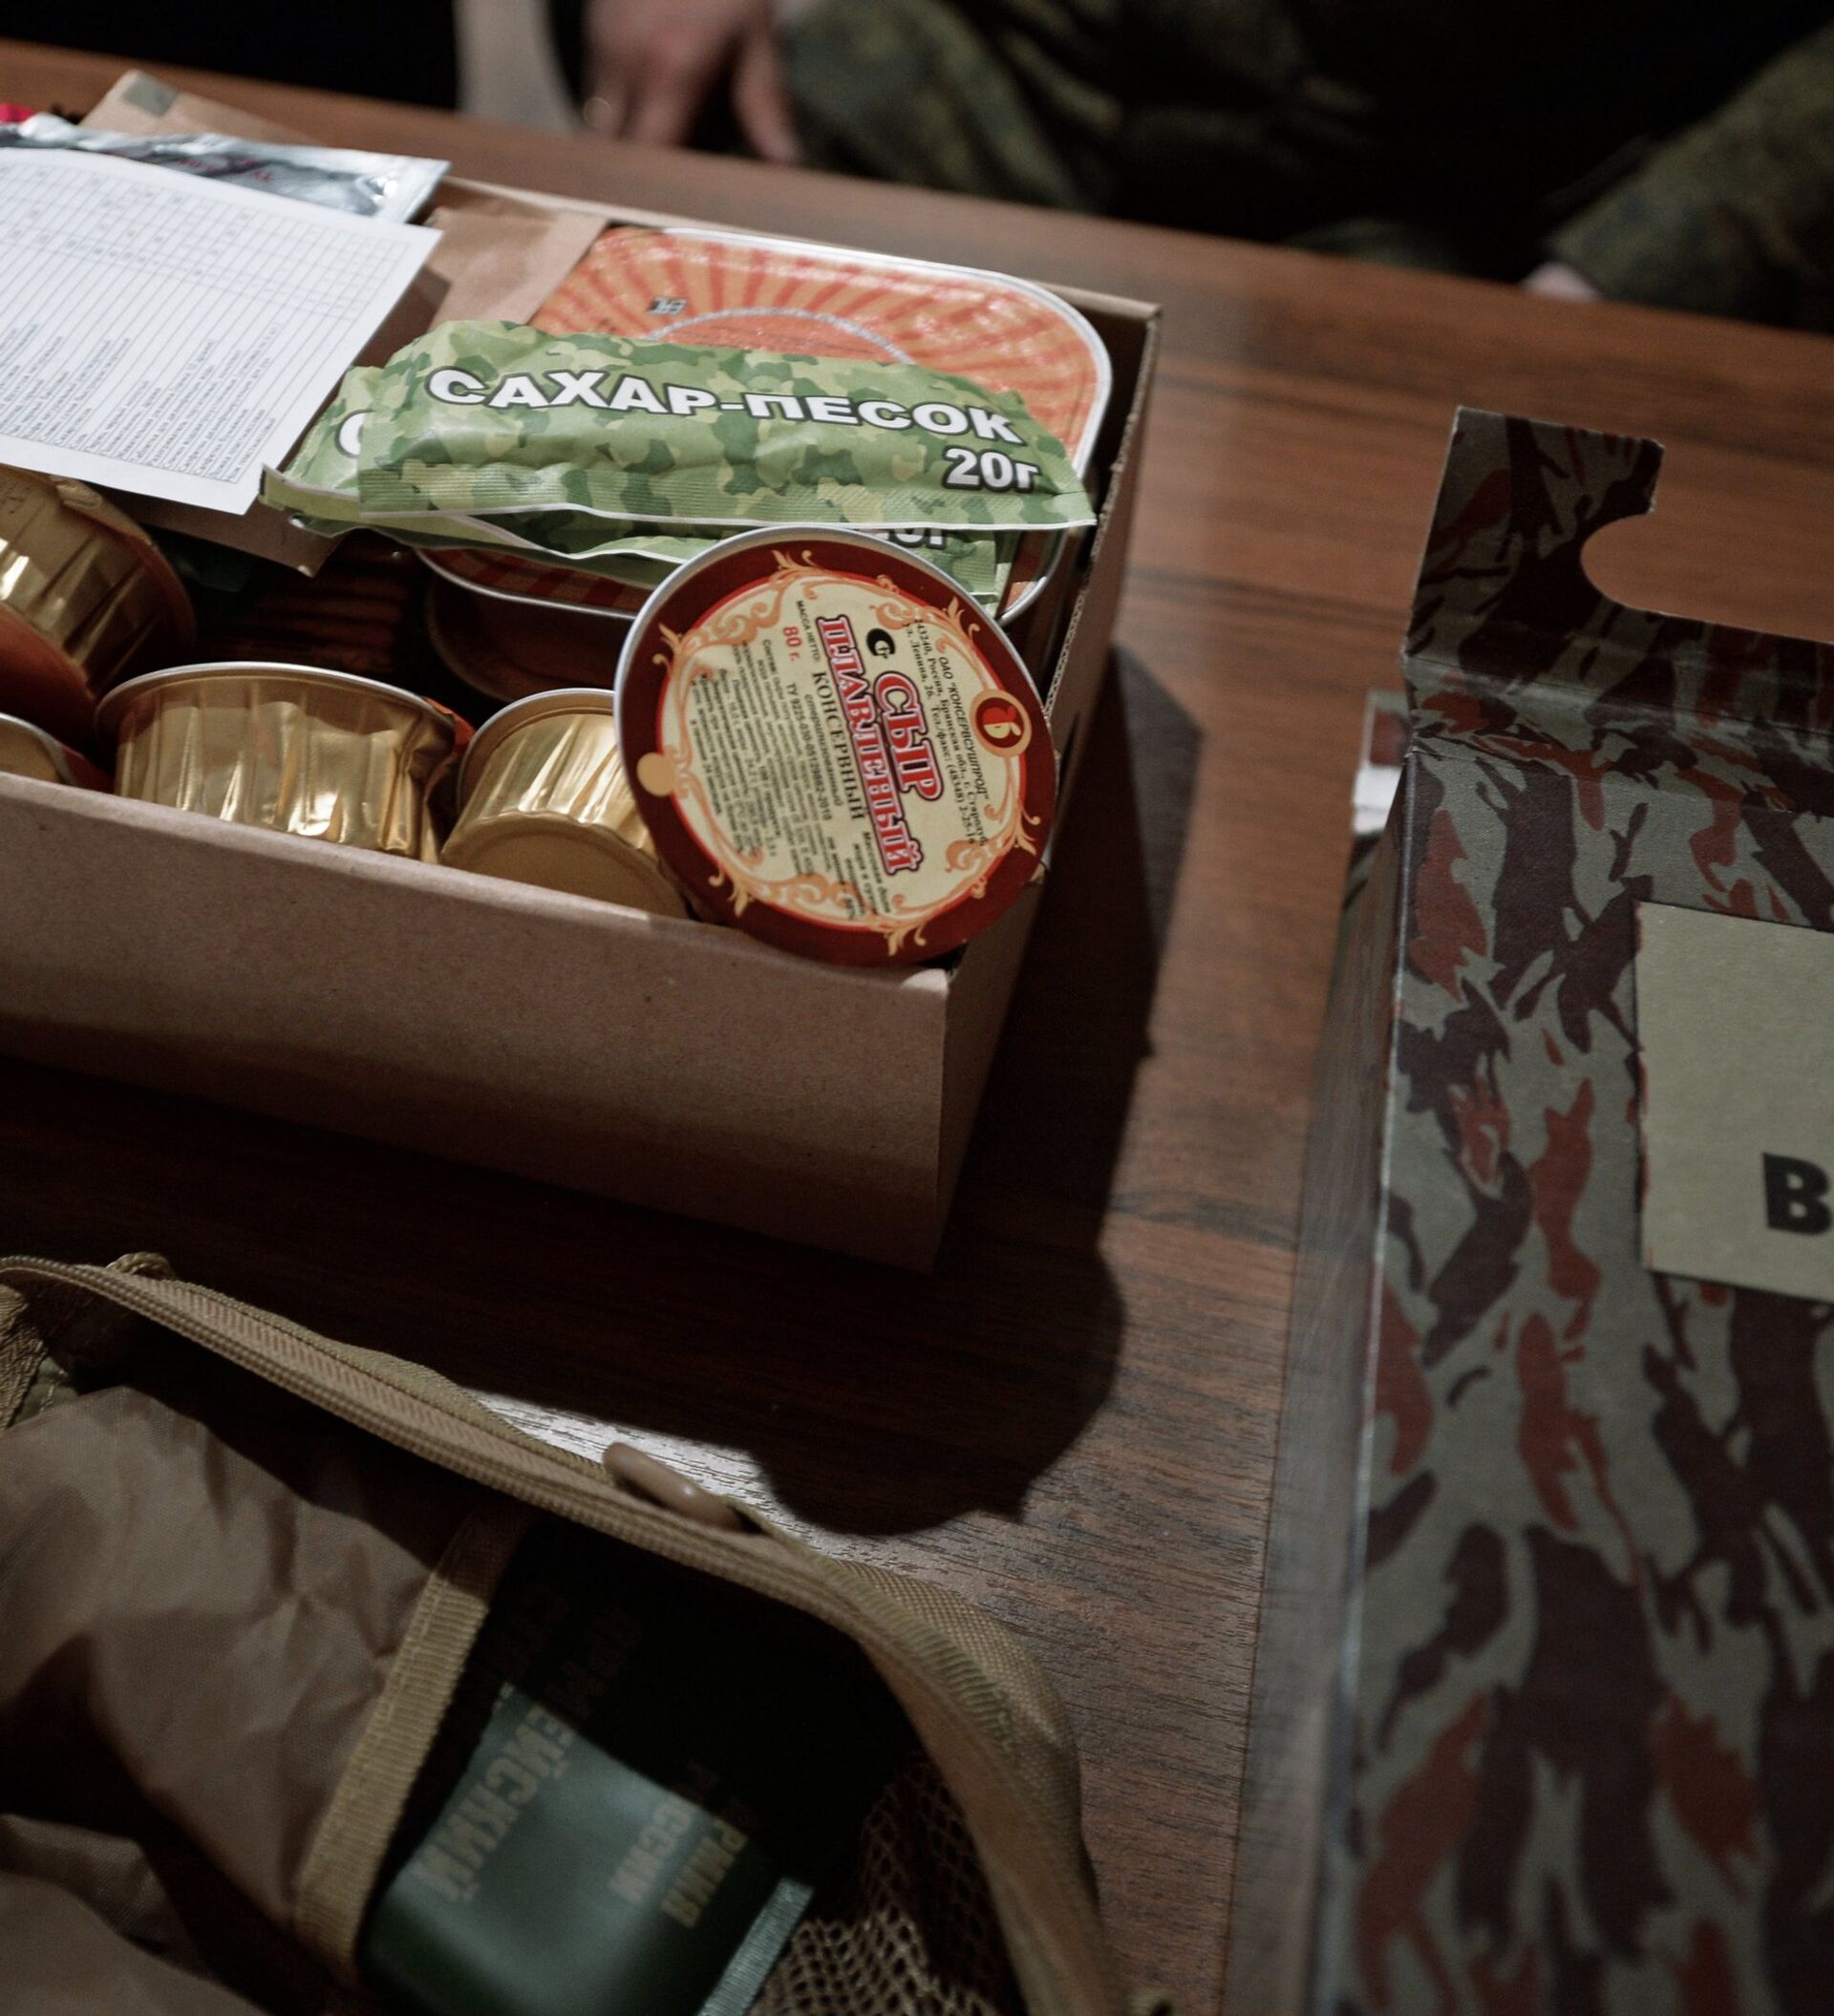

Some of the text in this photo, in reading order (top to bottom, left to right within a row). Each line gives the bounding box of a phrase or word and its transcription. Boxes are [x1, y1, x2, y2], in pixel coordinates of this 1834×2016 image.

[426, 366, 1028, 446] САХАР-ПЕСОК
[941, 445, 1041, 494] 20г
[780, 624, 802, 648] 80
[796, 600, 811, 630] МАССА
[937, 655, 953, 680] ОАО
[811, 668, 868, 821] КОНСЕРВНЫЙ
[815, 609, 926, 879] ПЛАВЛЕНЫЙ
[868, 665, 949, 809] СЫР
